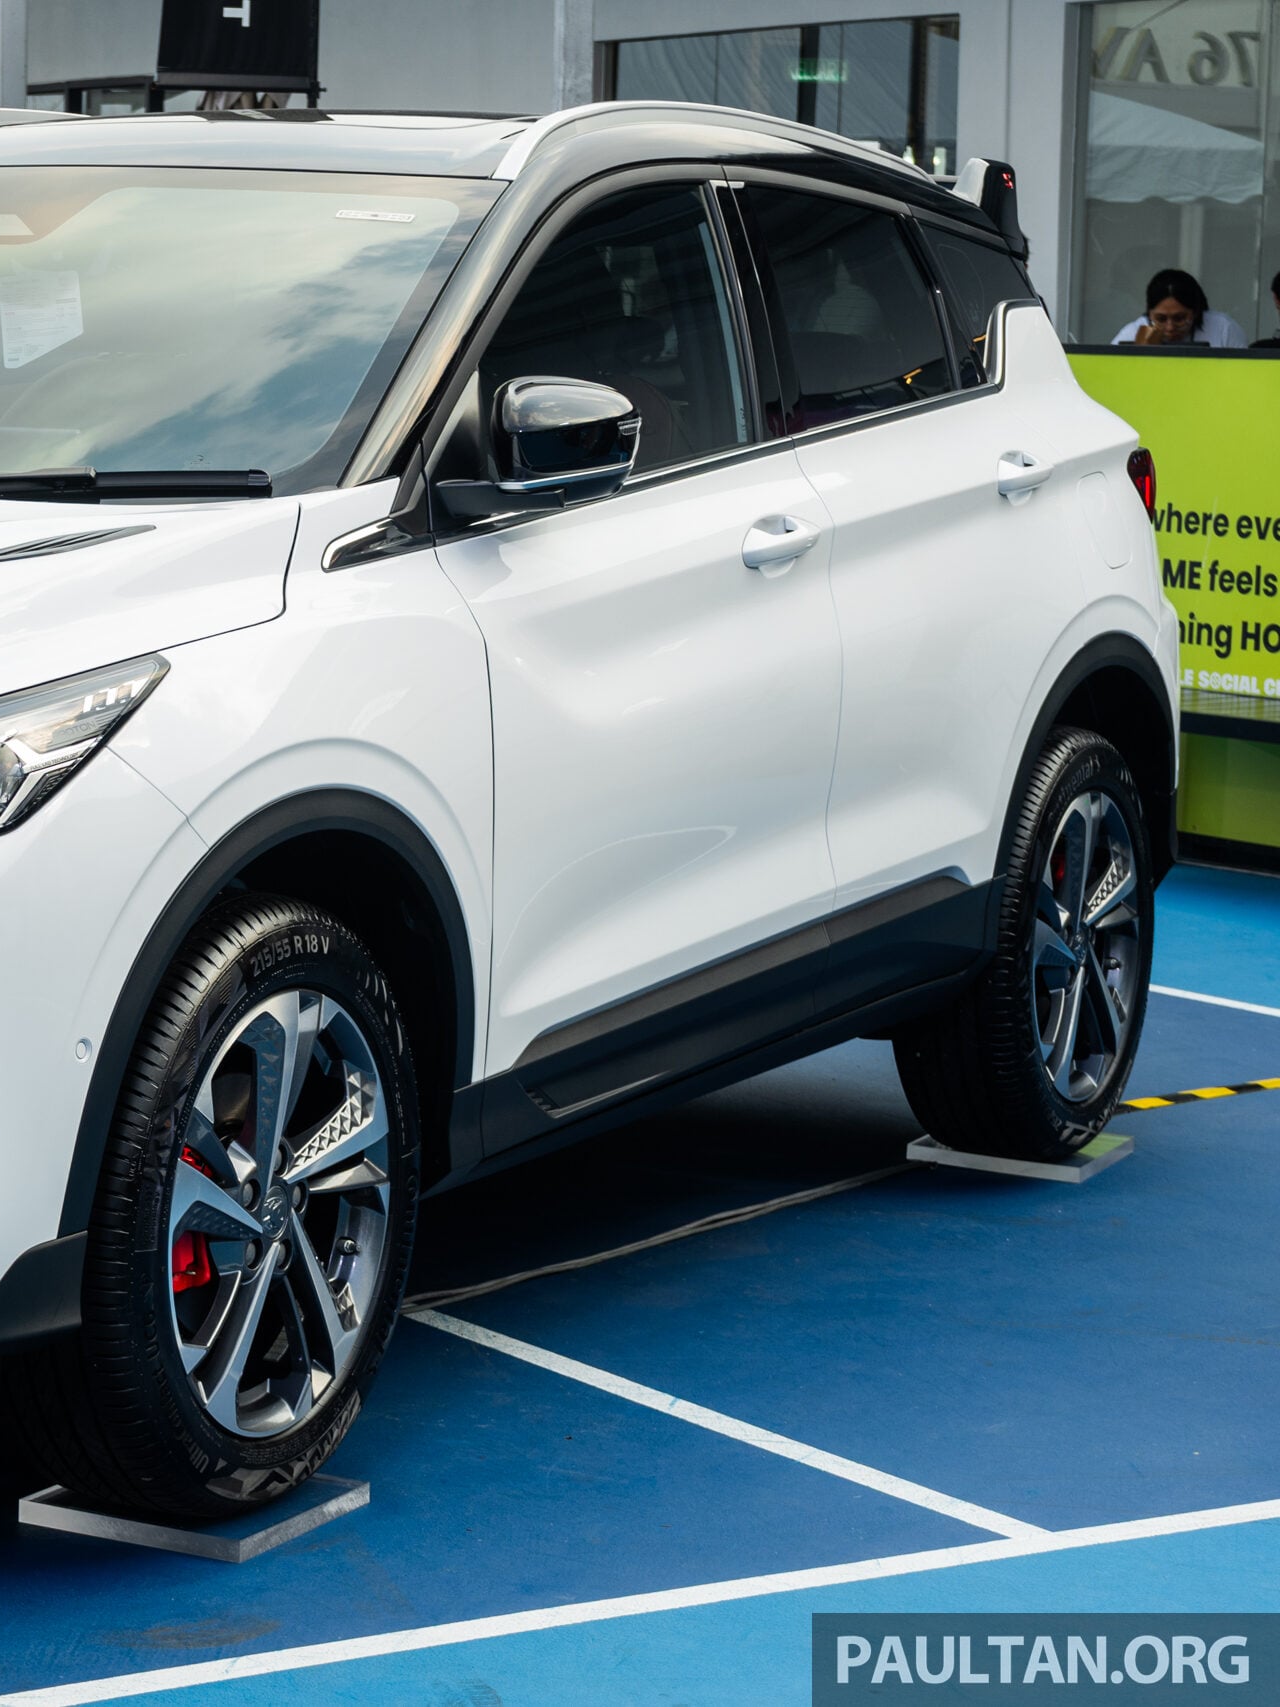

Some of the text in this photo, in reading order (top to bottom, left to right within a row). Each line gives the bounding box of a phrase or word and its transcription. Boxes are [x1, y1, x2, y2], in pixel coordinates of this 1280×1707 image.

[1209, 560, 1278, 597] feels
[1198, 670, 1260, 694] SOCIAL
[250, 937, 292, 977] 215/55
[293, 935, 304, 954] R
[304, 934, 319, 953] 18
[320, 935, 330, 955] V
